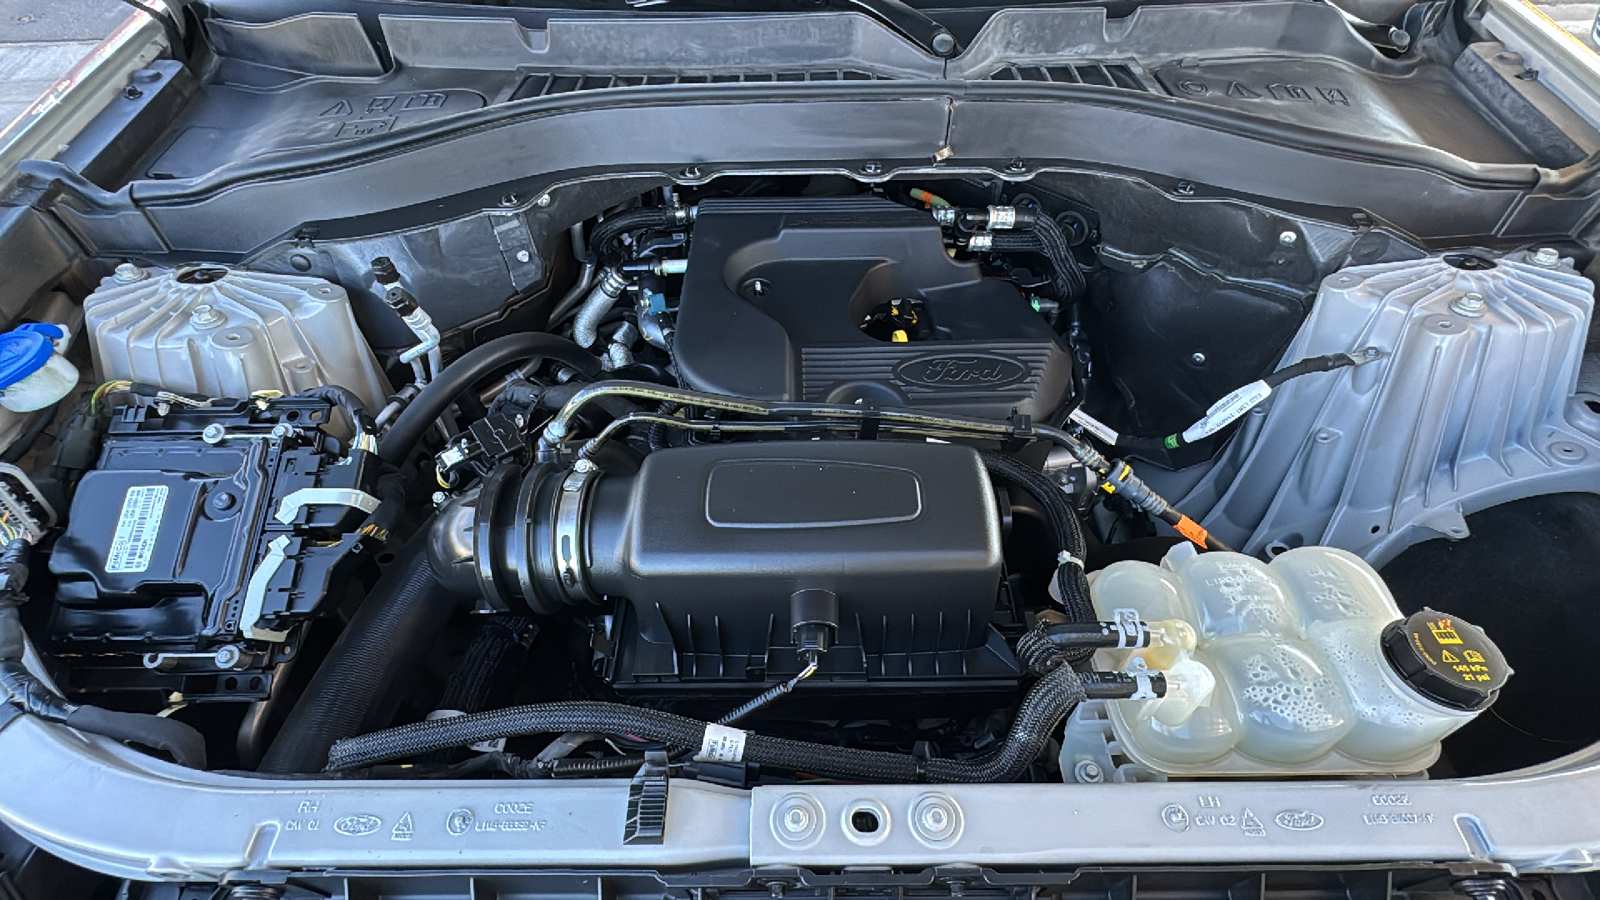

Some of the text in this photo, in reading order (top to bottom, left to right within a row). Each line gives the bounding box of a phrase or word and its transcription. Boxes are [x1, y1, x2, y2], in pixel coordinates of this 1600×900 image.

[922, 359, 1002, 382] Ford
[1452, 664, 1489, 673] 145 kPa
[1462, 672, 1491, 682] 21 psi
[297, 799, 320, 814] RH
[1199, 796, 1221, 808] LH
